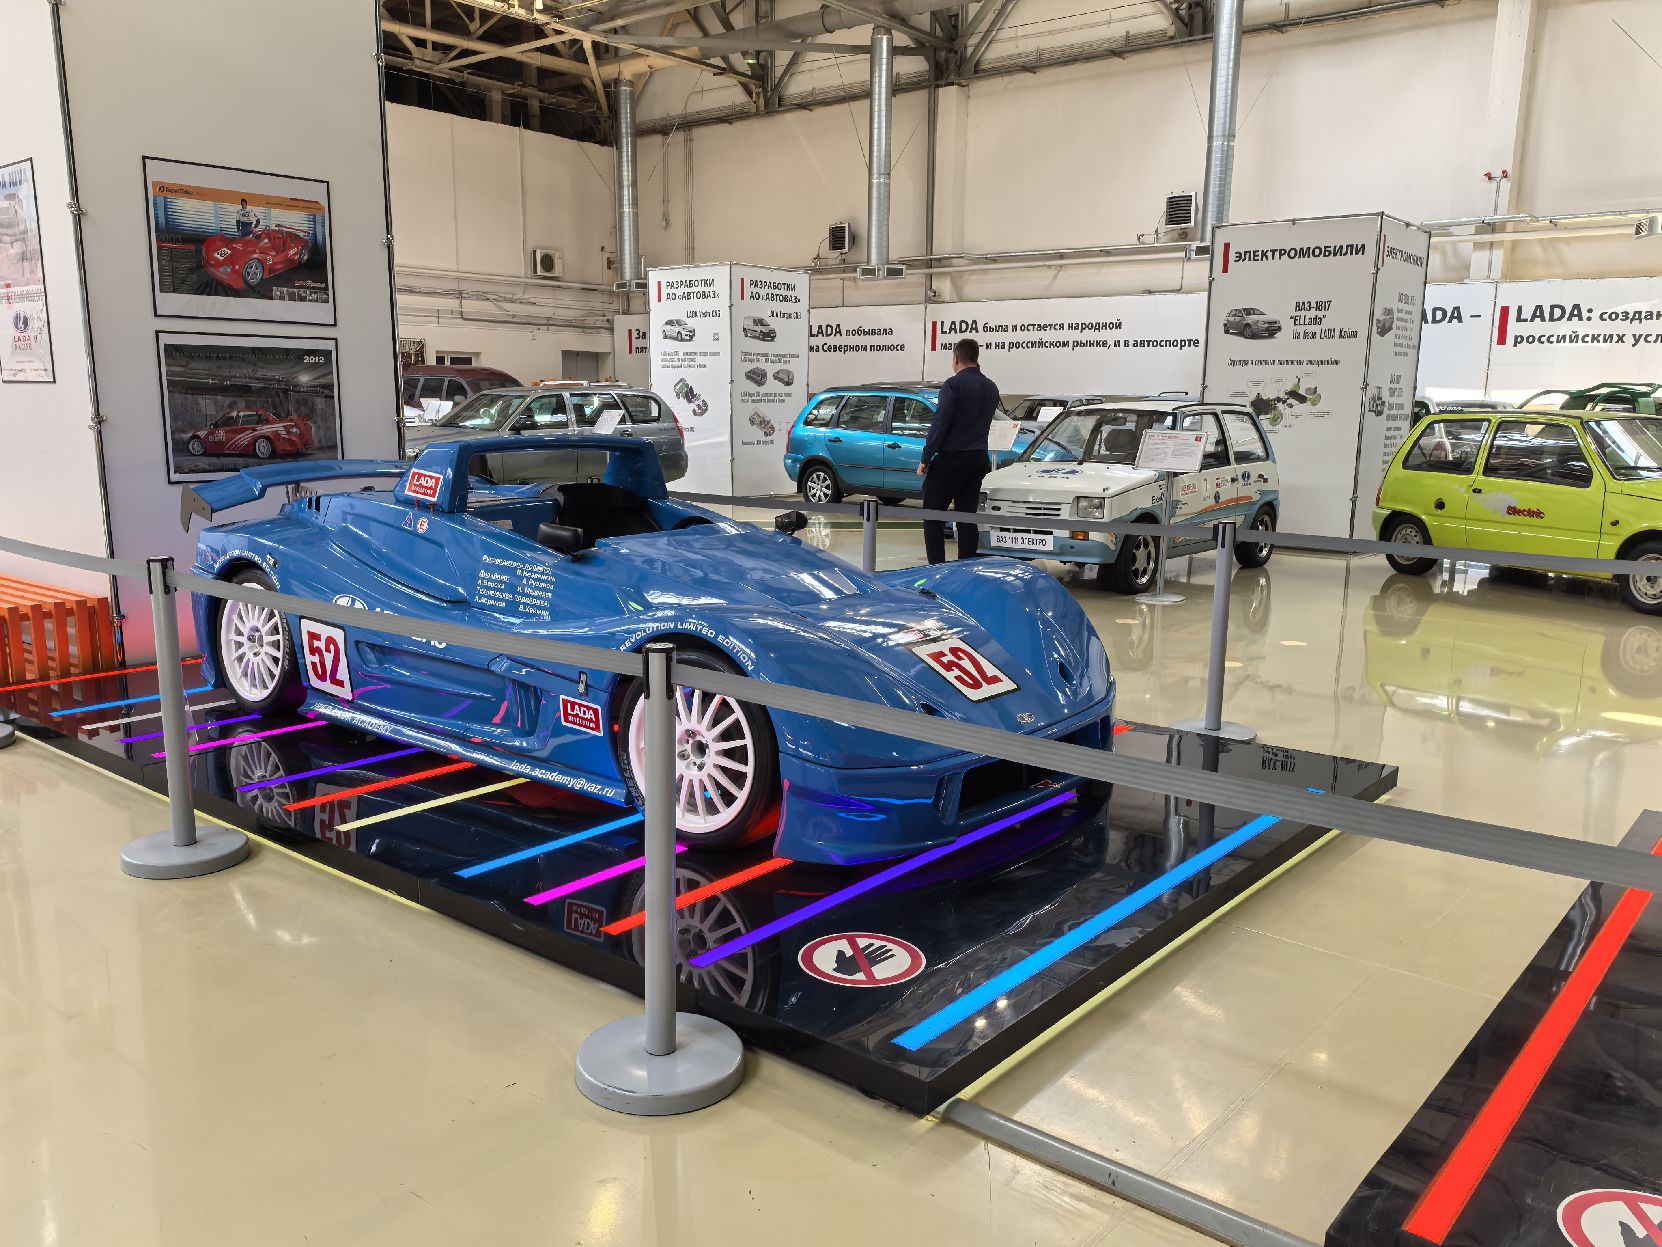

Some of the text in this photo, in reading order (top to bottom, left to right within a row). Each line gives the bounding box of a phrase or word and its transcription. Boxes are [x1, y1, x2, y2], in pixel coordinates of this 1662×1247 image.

[1234, 243, 1366, 263] ЭЛЕКТРОМОБИЛИ
[1385, 245, 1424, 268] ЭЛЕКТРОМОБИЛИ
[666, 278, 715, 290] РАЗРАБОТКИ
[749, 279, 796, 292] РАЗРАБОТКИ
[666, 289, 720, 301] АО «АВТОВАЗ»
[749, 291, 801, 304] АО «АВТОВАЗ»
[1294, 300, 1332, 313] ВАЗ-1817
[1515, 303, 1594, 324] LADA:
[635, 328, 647, 340] За
[809, 323, 894, 338] LADA побывала
[940, 319, 1123, 335] LADA была и остается народной
[1319, 328, 1336, 340] LADA
[1338, 327, 1358, 340] Kalina
[985, 341, 992, 350] и
[994, 341, 1006, 350] на
[1008, 337, 1070, 352] российском
[1072, 338, 1111, 351] рынке,
[1113, 339, 1121, 348] и
[1123, 339, 1130, 348] в
[1132, 337, 1200, 351] автоспорте
[1513, 330, 1627, 348] российских
[821, 342, 868, 355] Северном
[869, 342, 905, 353] полюсе
[303, 355, 326, 364] 2012
[413, 474, 436, 489] LADA
[1505, 504, 1546, 519] Electric
[996, 535, 1008, 544] ВАЗ
[1020, 536, 1047, 547] ЭЛЕКТРО
[619, 621, 755, 672] REVOLUTION LIMITED EDITION
[306, 630, 345, 689] 52
[925, 645, 1004, 690] 52
[567, 702, 596, 722] LADA
[351, 715, 394, 735] ACADEMY
[511, 759, 616, 798] lada.academy@vaz.ru
